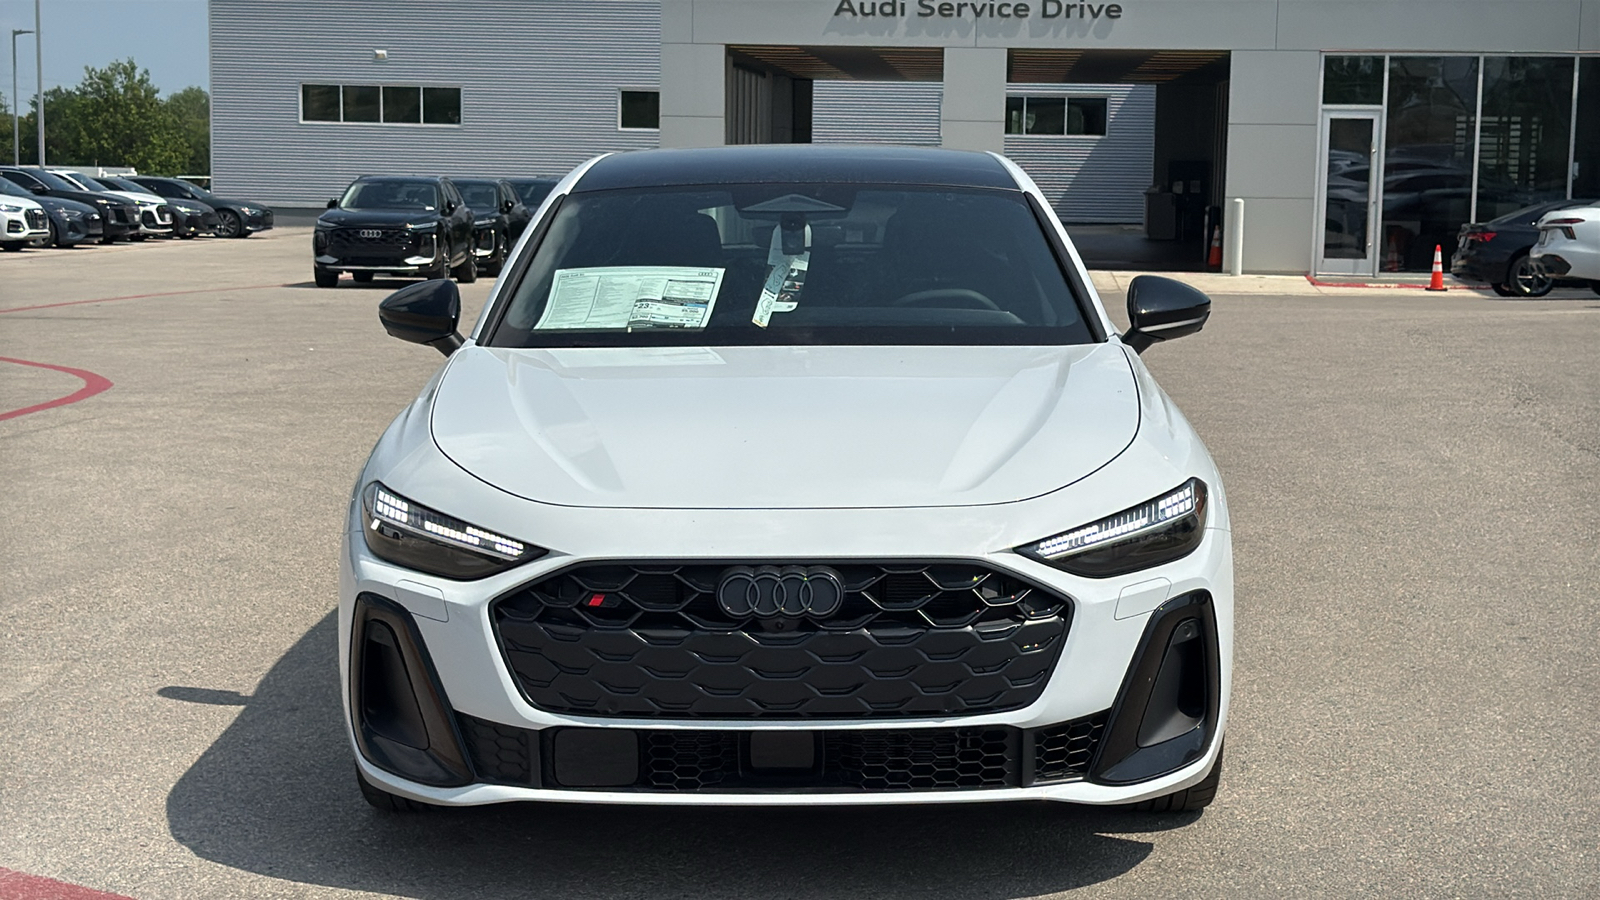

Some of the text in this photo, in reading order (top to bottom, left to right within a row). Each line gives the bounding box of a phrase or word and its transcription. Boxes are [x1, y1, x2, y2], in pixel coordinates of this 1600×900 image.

[834, 0, 1122, 19] Audi Service Drive
